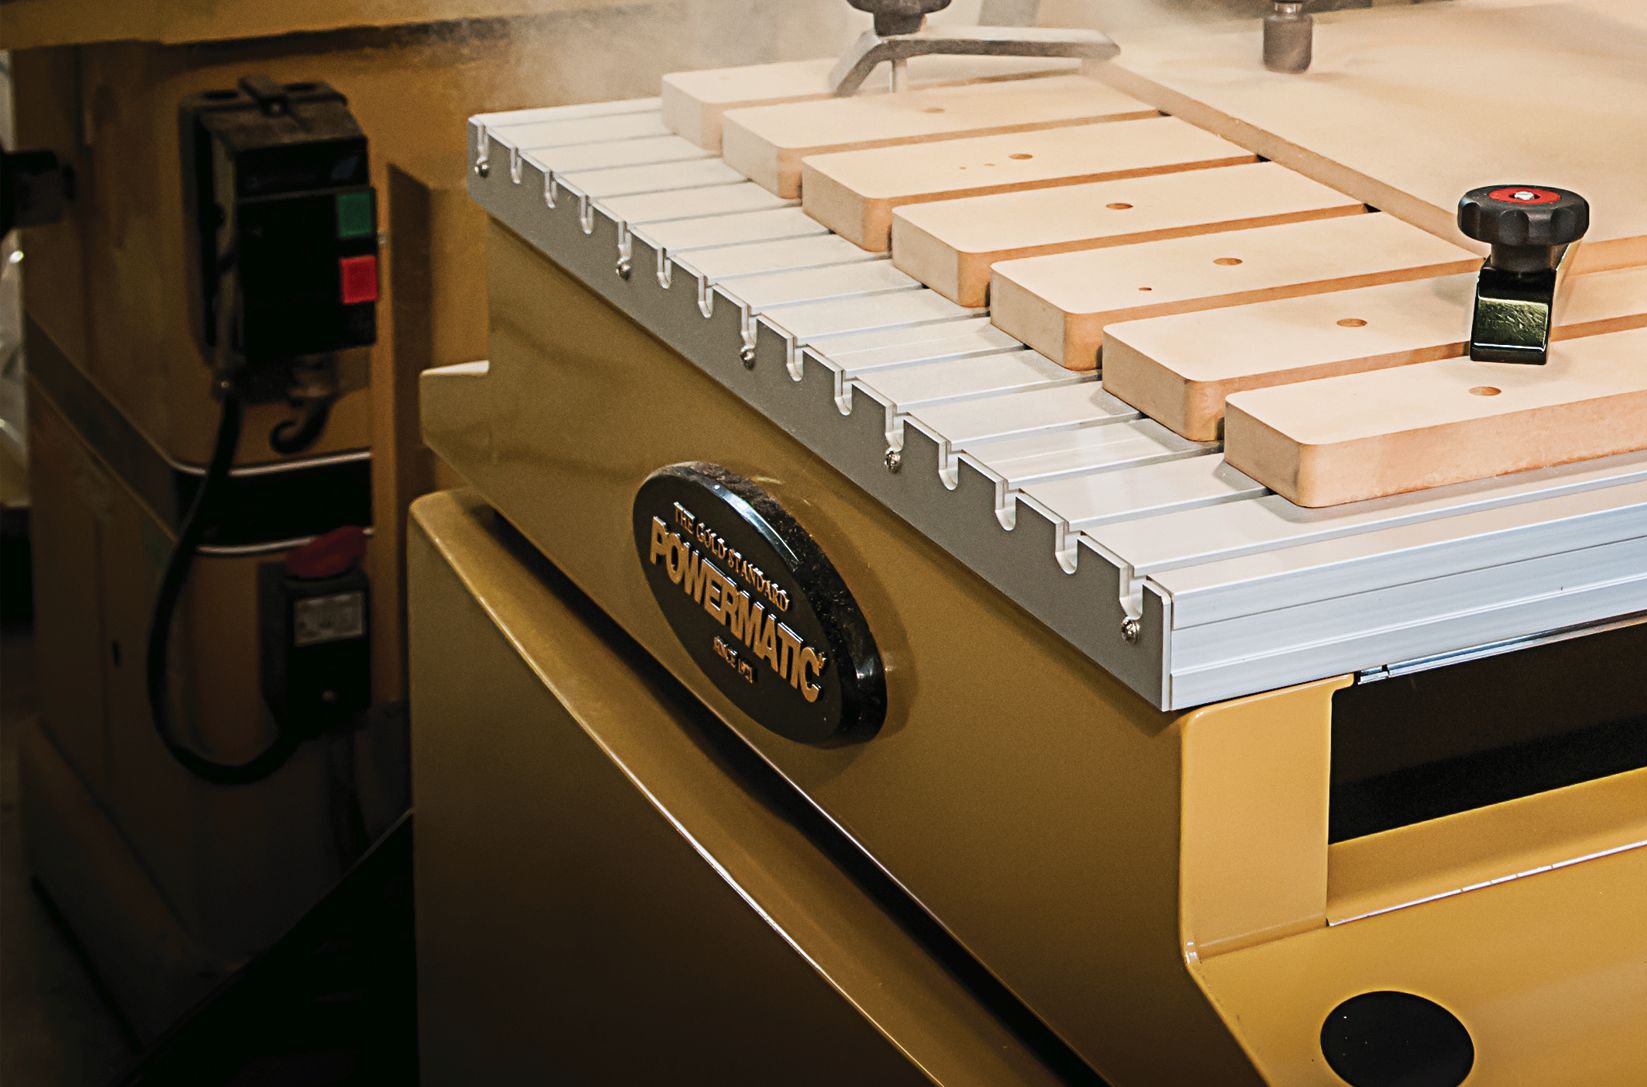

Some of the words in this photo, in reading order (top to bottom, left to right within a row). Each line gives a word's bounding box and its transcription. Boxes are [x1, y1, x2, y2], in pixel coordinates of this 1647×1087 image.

[650, 515, 823, 703] POWERMATIC
[673, 501, 696, 535] THE
[696, 522, 728, 560] GOLD
[727, 547, 790, 612] STANDARD
